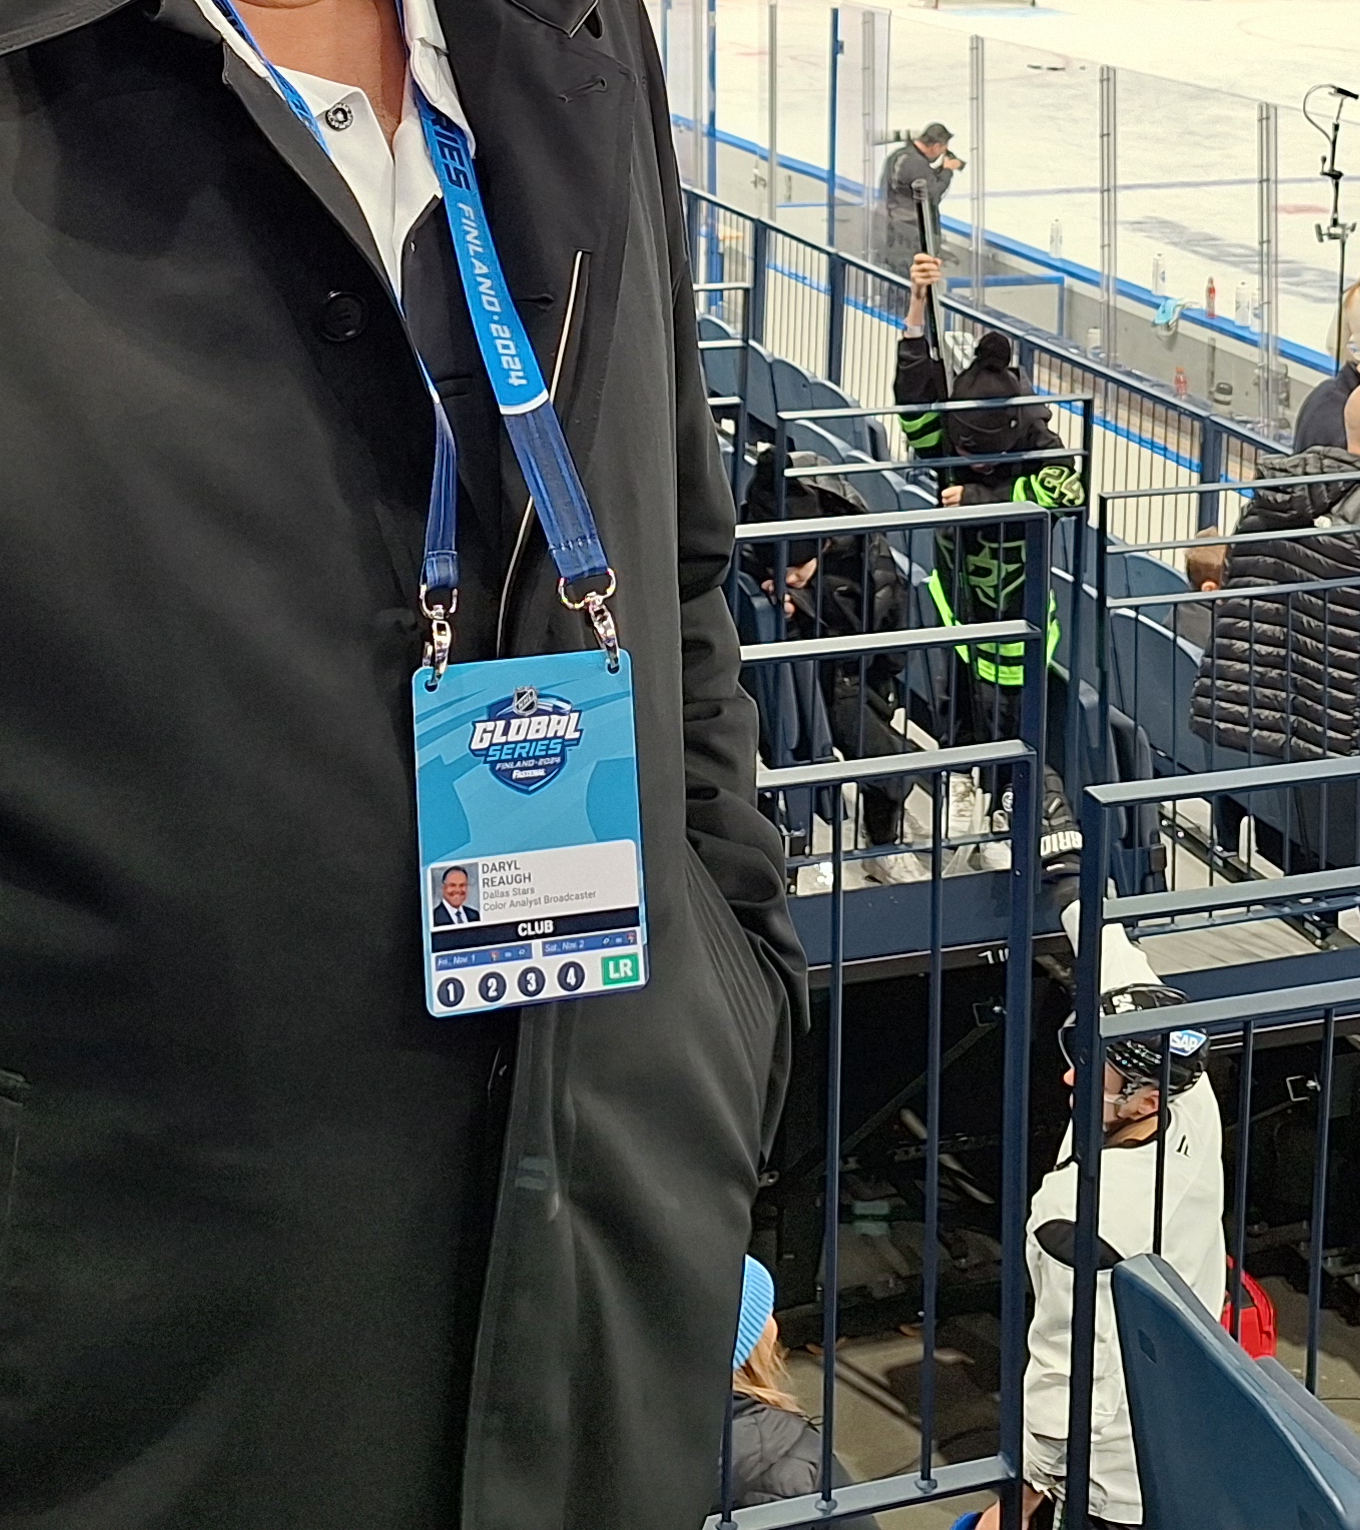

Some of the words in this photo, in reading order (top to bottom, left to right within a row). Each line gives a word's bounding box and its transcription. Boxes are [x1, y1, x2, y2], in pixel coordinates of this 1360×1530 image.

[457, 202, 502, 312] FINLAND
[490, 322, 528, 387] 2024
[1038, 466, 1085, 506] 24
[470, 712, 580, 750] GLOBAL
[486, 739, 562, 761] SERIES
[496, 759, 534, 770] FINLAND
[481, 860, 521, 874] DARYL
[482, 872, 532, 888] REAUGH
[482, 889, 510, 900] Dallas
[512, 886, 535, 897] Stars
[483, 900, 507, 911] Color
[509, 896, 542, 910] Analyst
[544, 890, 597, 904] Broadcaster
[517, 920, 554, 937] CLUB
[447, 983, 456, 1002] 1
[487, 978, 498, 997] 2
[526, 972, 536, 991] 3
[566, 967, 577, 986] 4
[607, 958, 634, 980] LR
[1171, 1034, 1198, 1049] SAP
